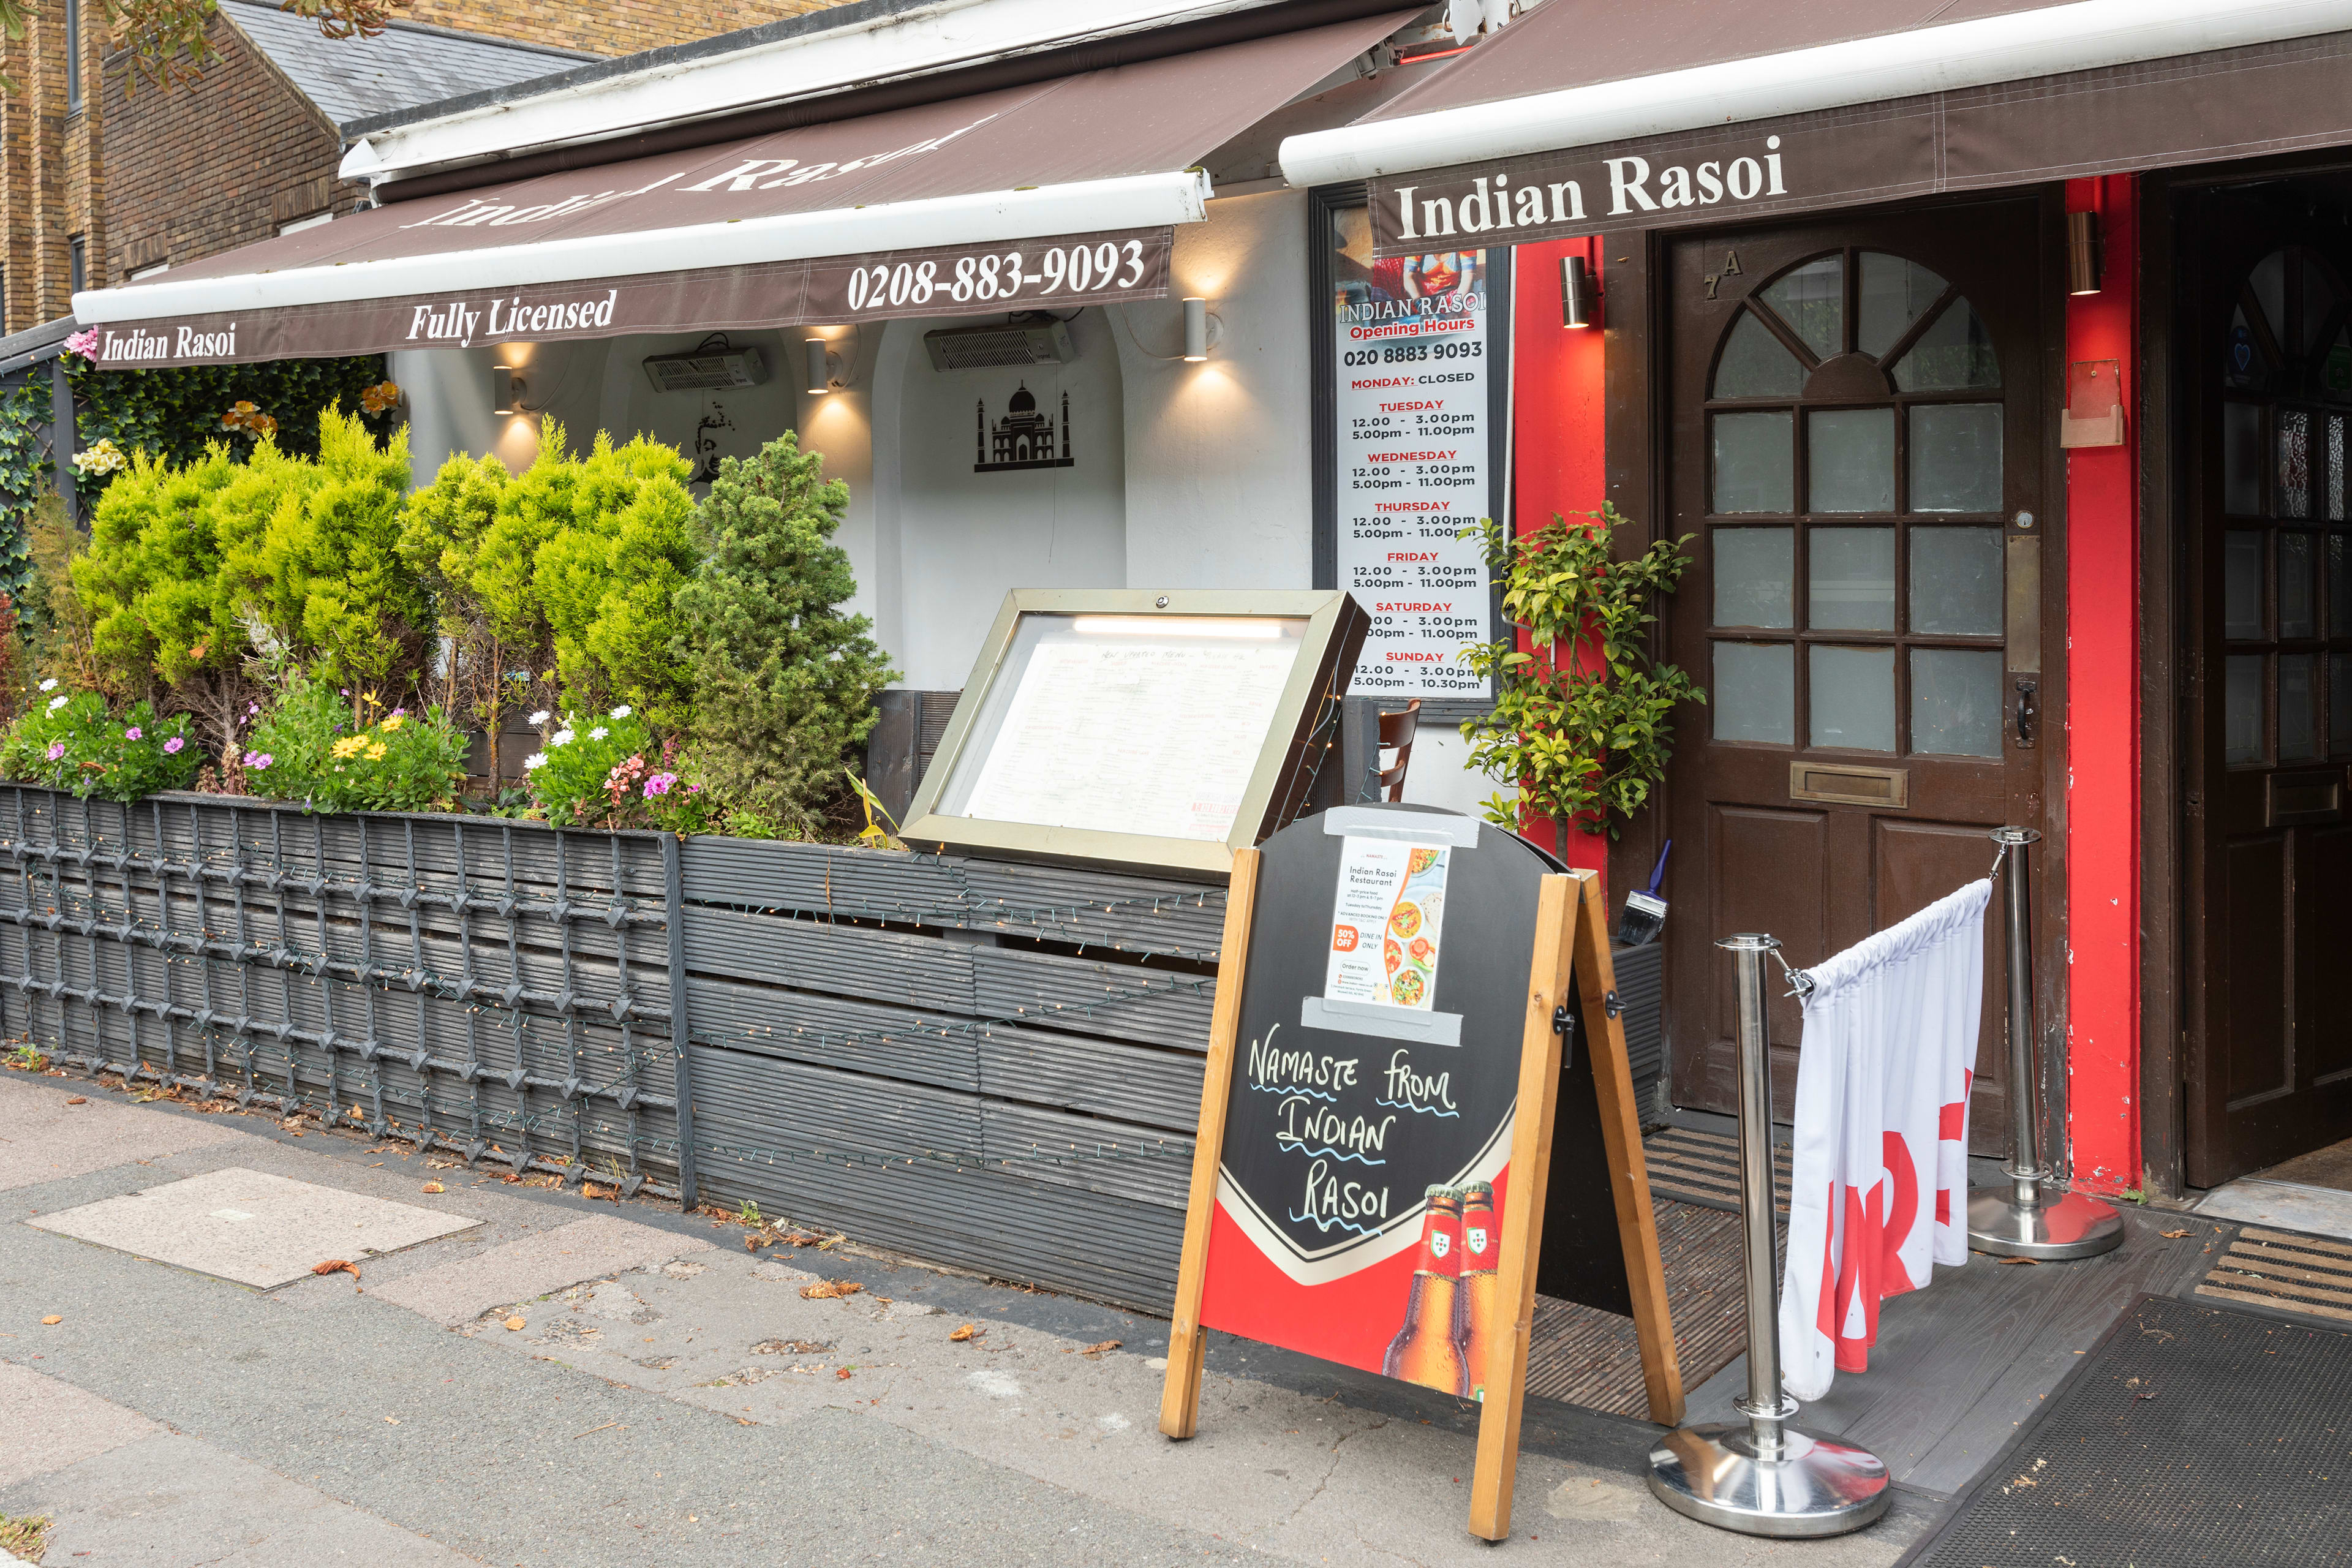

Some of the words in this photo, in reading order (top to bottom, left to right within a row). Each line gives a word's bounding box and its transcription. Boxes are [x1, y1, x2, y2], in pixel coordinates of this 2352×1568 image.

[1394, 173, 1586, 239] Indian
[1603, 135, 1788, 216] Rasoi
[848, 239, 1145, 311] 0208-883-9093
[1340, 298, 1411, 323] INDIAN
[1420, 291, 1486, 314] RASOI
[405, 303, 480, 347] Fully
[485, 290, 617, 335] Licensed
[1350, 322, 1419, 339] Opening
[1425, 318, 1475, 333] Hours
[100, 328, 168, 361] Indian
[173, 322, 236, 358] Rasoi
[1344, 350, 1378, 366] 020
[1384, 345, 1428, 363] 8883
[1434, 341, 1482, 360] 9093
[1351, 377, 1414, 389] MONDAY:
[1419, 372, 1475, 384] CLOSED
[1379, 400, 1444, 412] TUESDAY
[1352, 417, 1390, 428] 12.00
[1415, 413, 1475, 424] 3.00pm
[1352, 429, 1401, 440] 5.00pm
[1418, 426, 1475, 436] 11.00pm
[1368, 450, 1457, 462] WEDNESDAY
[1352, 467, 1390, 477] 12.00
[1416, 465, 1475, 474] 3.00pm
[1352, 480, 1402, 489] 5.00pm
[1418, 477, 1475, 487] 11.00pm
[1375, 502, 1450, 511] THURSDAY
[1353, 517, 1391, 526] 12.00
[1417, 516, 1476, 526] 3.00pm
[1353, 530, 1403, 540] 5.00pm
[1387, 552, 1439, 561] FRIDAY
[1353, 567, 1392, 576] 12.00
[1418, 566, 1477, 576] 3.00pm
[1354, 579, 1404, 589] 5.00pm
[1420, 579, 1477, 589] 11.00pm
[1376, 603, 1452, 611] SATURDAY
[1370, 616, 1393, 625] .00
[1419, 617, 1477, 627] 3.00pm
[1367, 628, 1404, 638] 00pm
[1421, 629, 1477, 639] 11.00pm
[1386, 652, 1444, 662] SUNDAY
[1355, 665, 1393, 674] 12.00
[1354, 677, 1404, 687] 5.00pm
[1421, 679, 1480, 690] 10.30pm
[1350, 866, 1373, 875] Indian
[1350, 875, 1392, 886] Restaurant
[1338, 929, 1355, 939] 50%
[1336, 938, 1352, 948] OFF
[1249, 1023, 1359, 1091] NAMASTE
[1276, 1096, 1396, 1153] INDIAN
